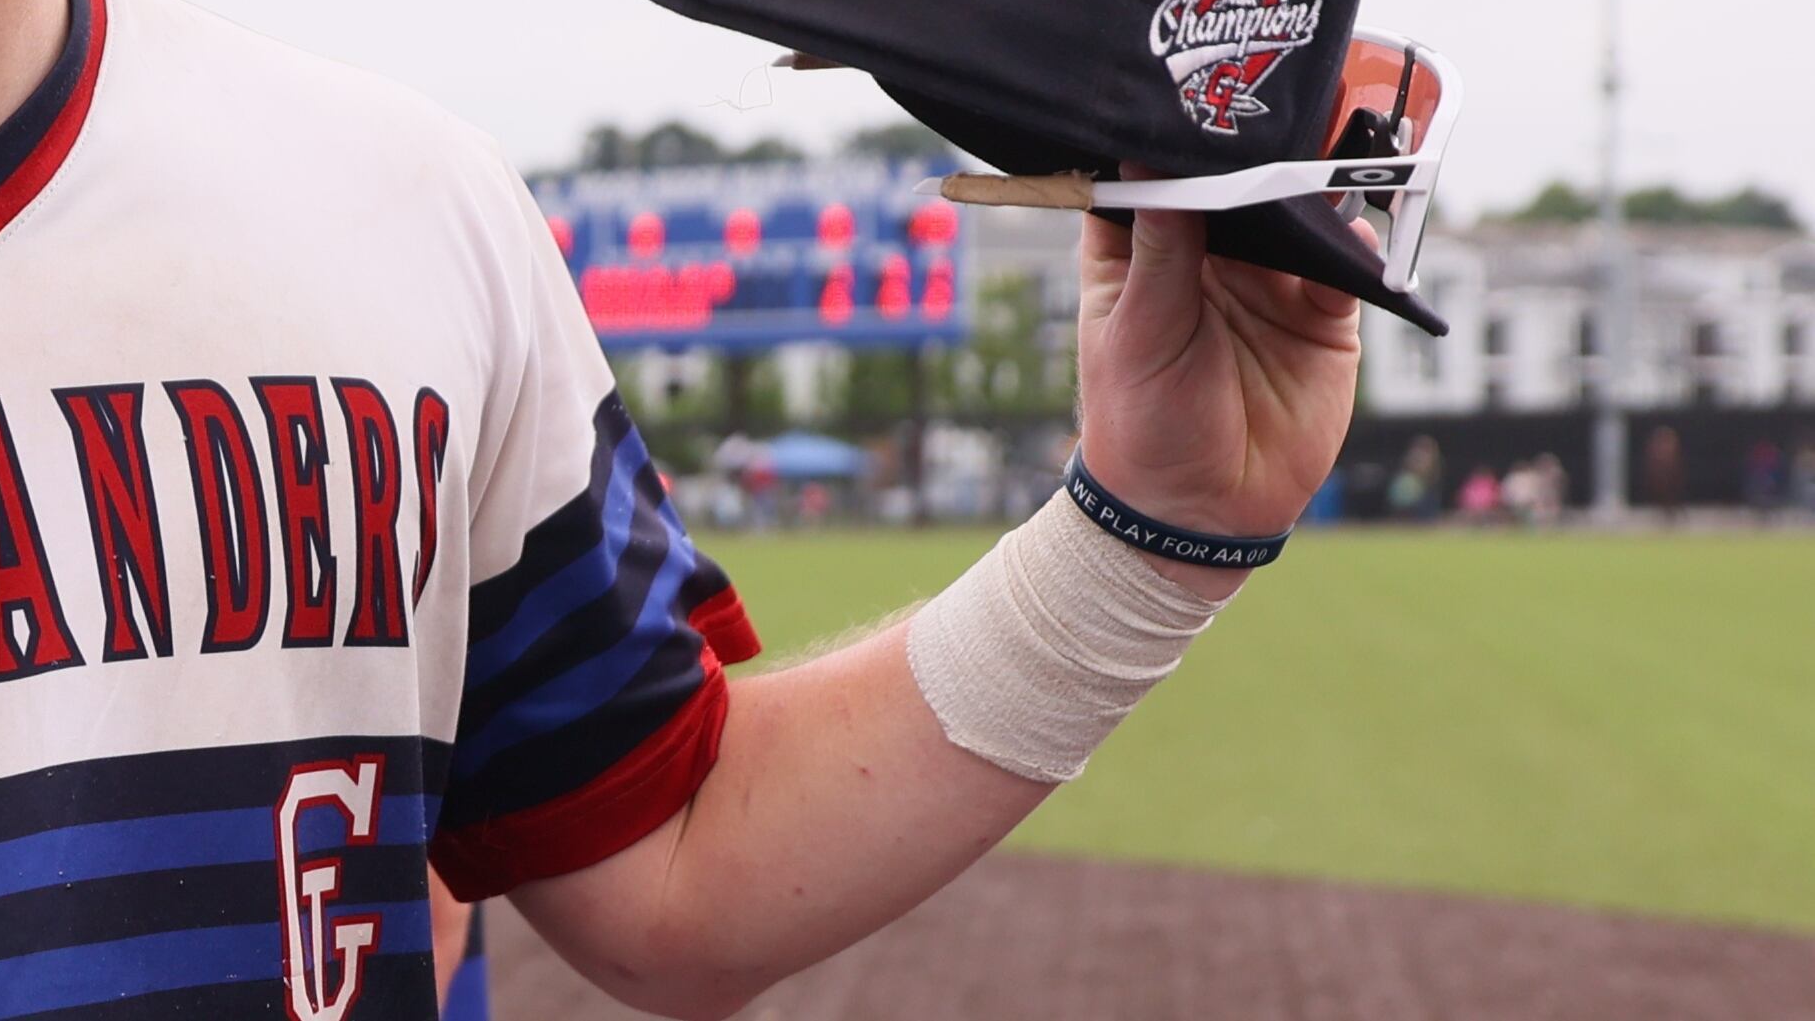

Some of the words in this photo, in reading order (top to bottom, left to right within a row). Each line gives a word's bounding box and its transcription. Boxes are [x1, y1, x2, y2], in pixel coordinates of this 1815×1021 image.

[1072, 477, 1098, 513] WE
[1099, 506, 1158, 545] PLAY
[1161, 535, 1210, 560] FOR
[1211, 547, 1243, 563] AA
